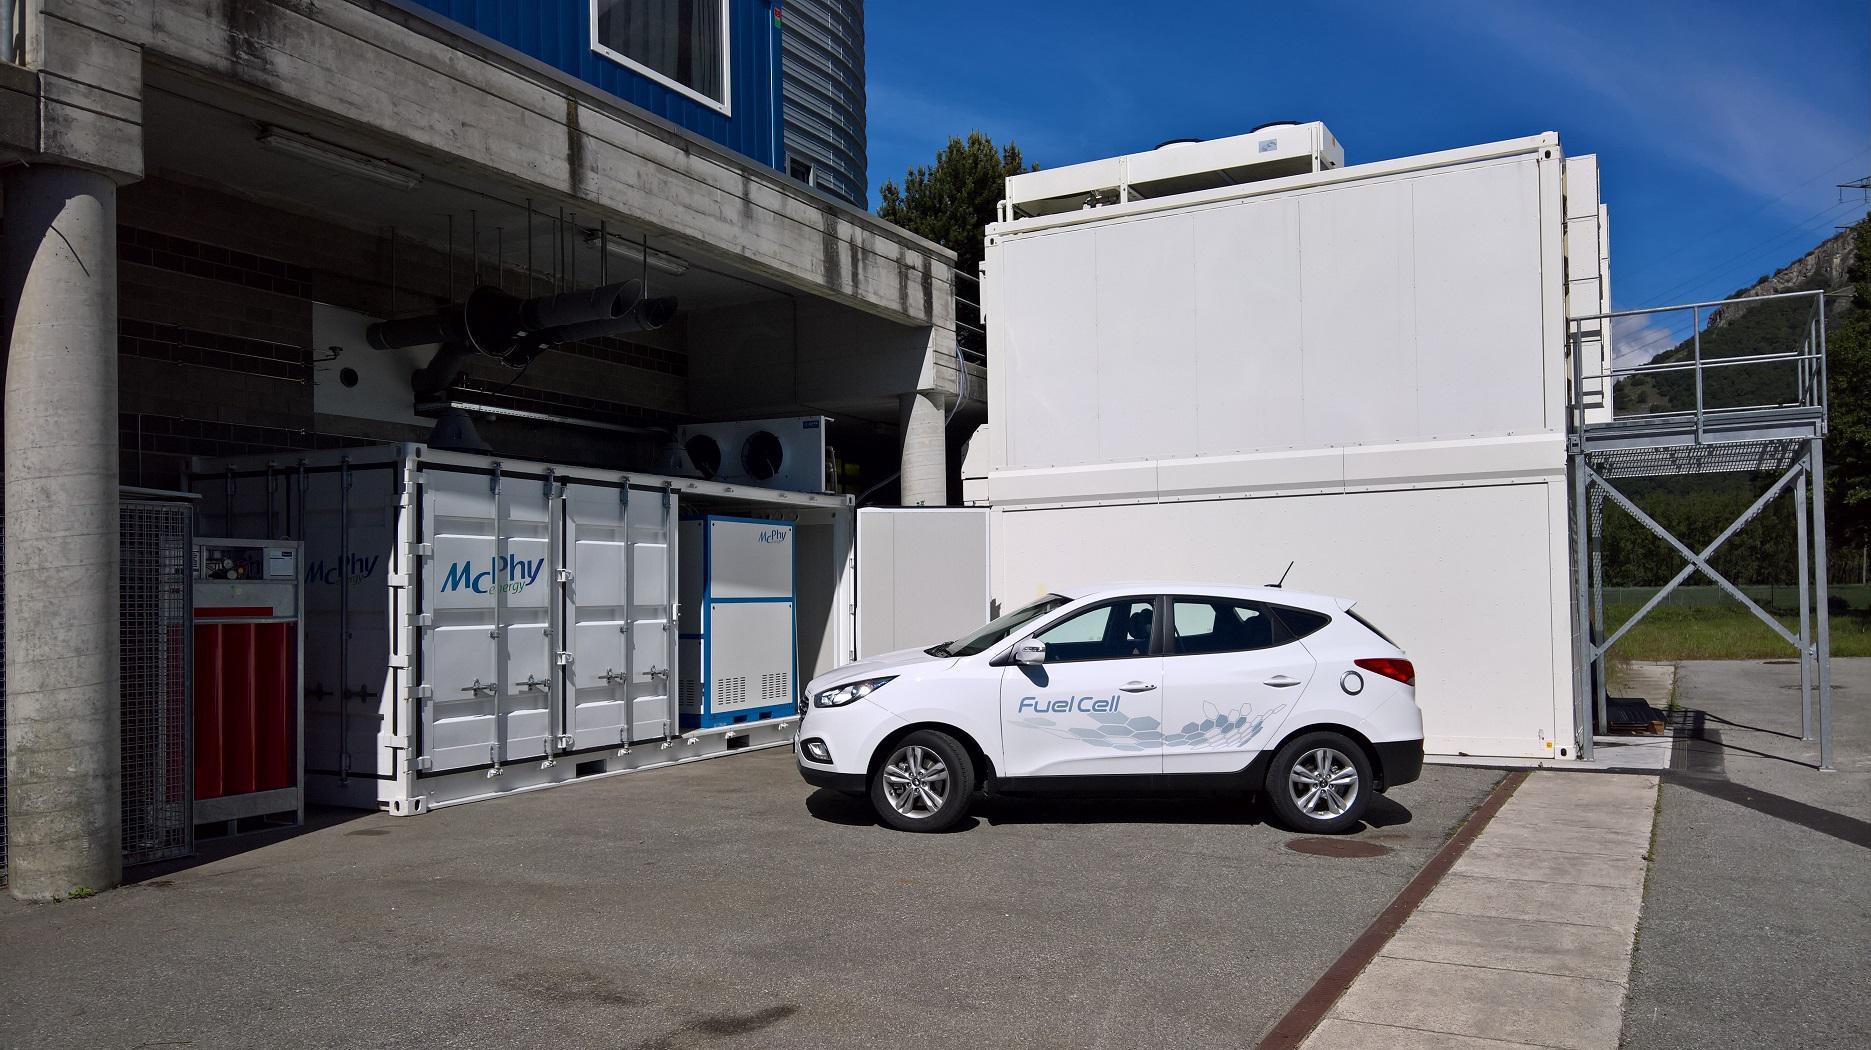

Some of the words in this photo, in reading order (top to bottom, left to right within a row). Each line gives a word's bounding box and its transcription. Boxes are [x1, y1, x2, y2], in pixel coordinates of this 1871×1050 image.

[758, 529, 787, 543] McPhy
[440, 553, 545, 593] McPhy
[1018, 695, 1075, 713] Fuel
[1077, 695, 1120, 713] Cell
